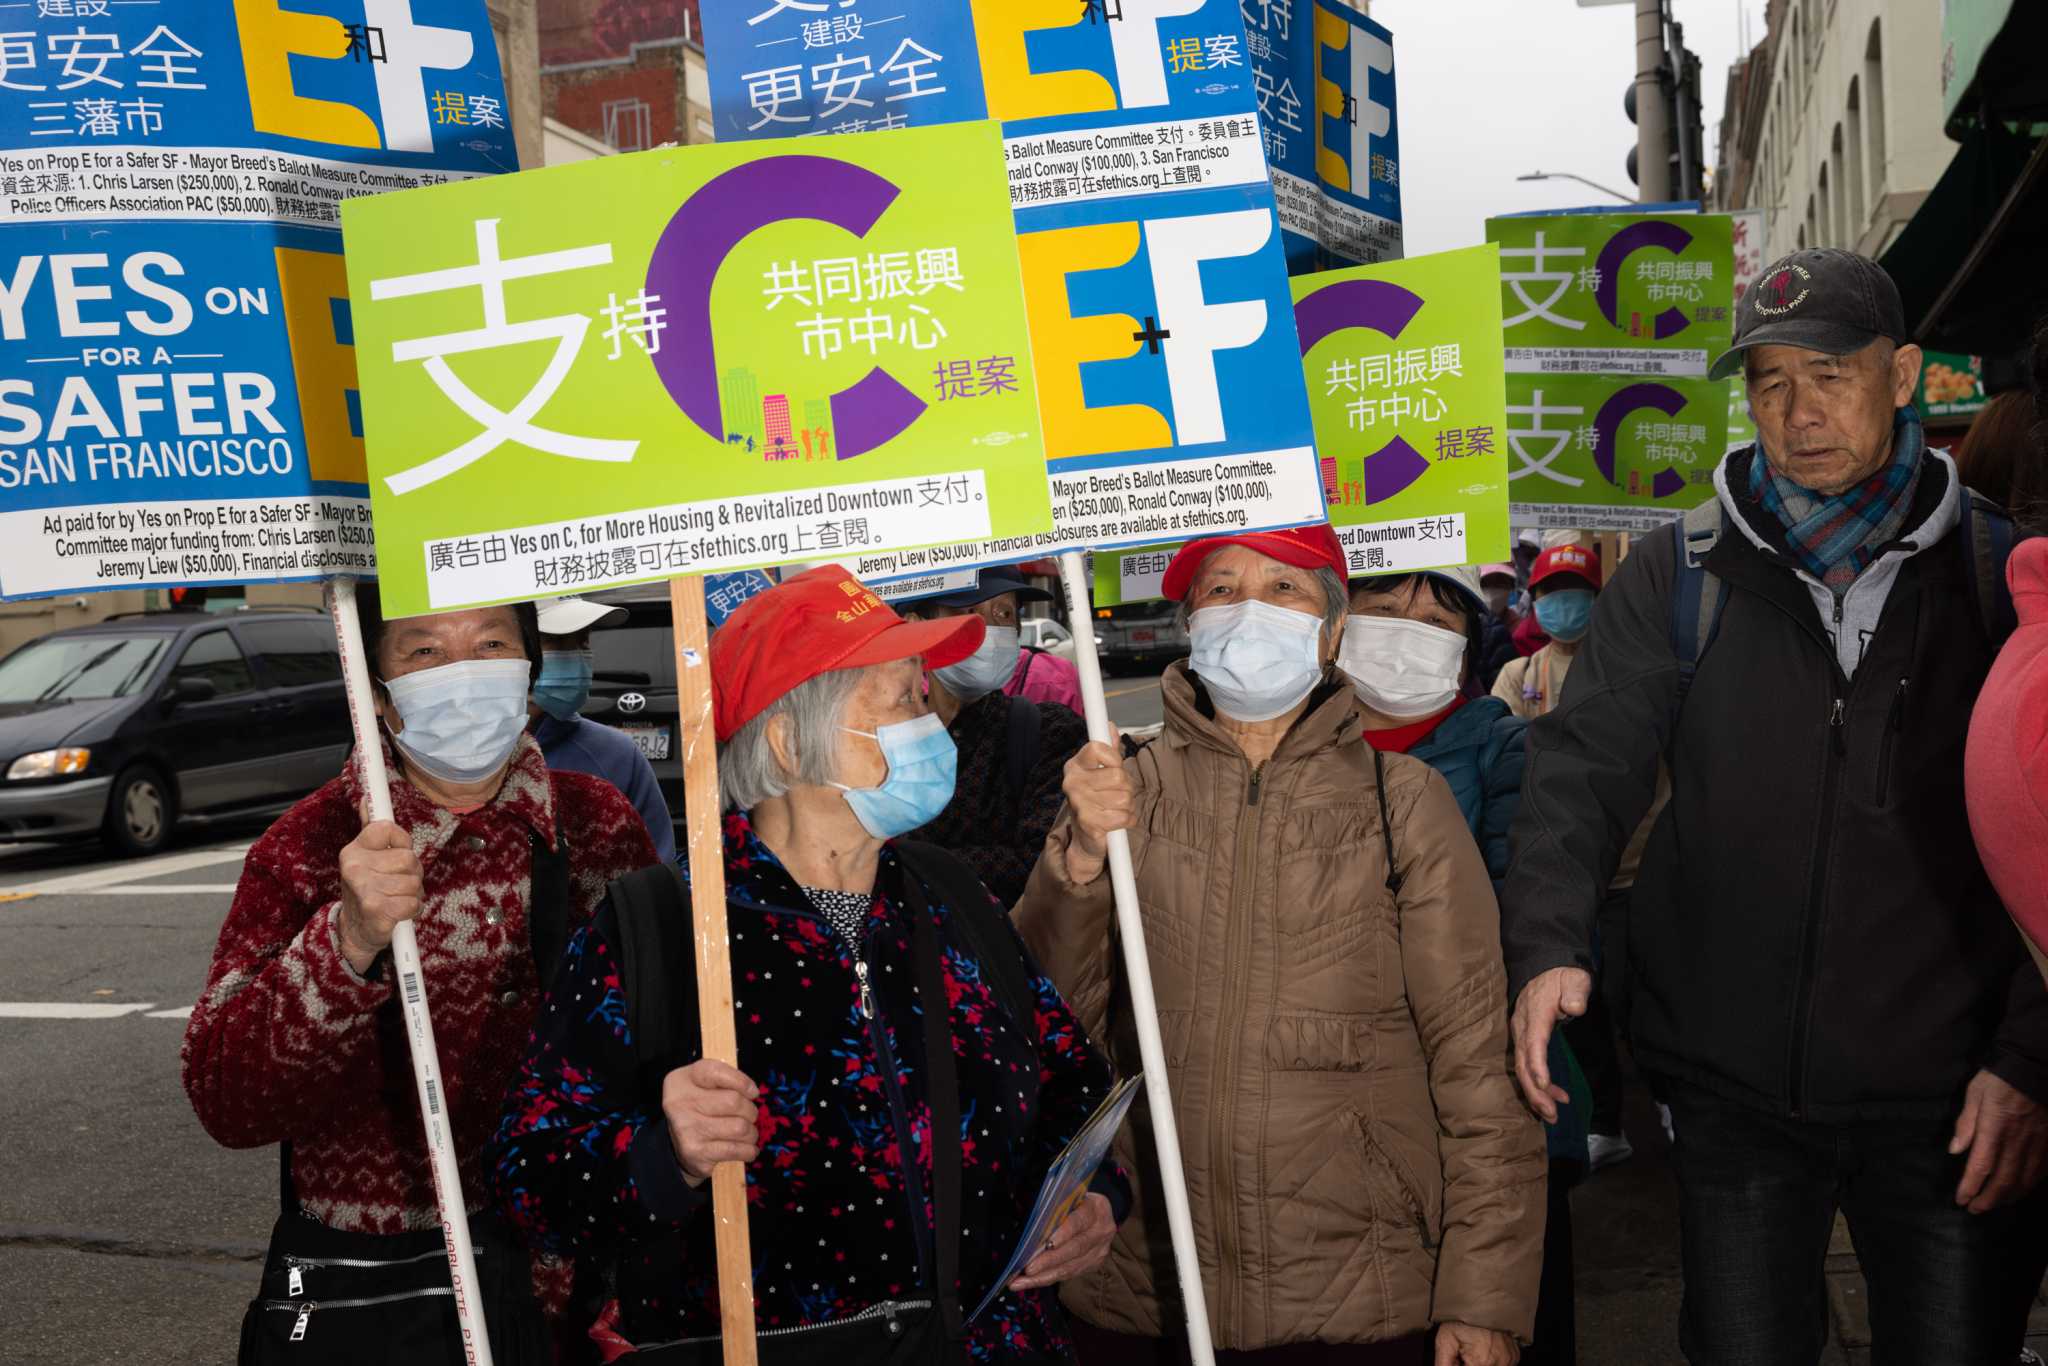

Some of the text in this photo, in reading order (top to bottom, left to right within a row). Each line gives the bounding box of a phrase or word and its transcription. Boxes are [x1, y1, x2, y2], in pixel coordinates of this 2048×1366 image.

[800, 13, 865, 50] 建設
[1166, 33, 1243, 74] 提案
[741, 38, 946, 132] 更安全
[28, 96, 164, 136] 三藩市
[432, 90, 506, 129] 提案
[1012, 142, 1045, 160] Ballot
[1046, 136, 1093, 155] Measure
[1095, 129, 1154, 150] Committee
[1034, 156, 1078, 177] Conway
[1081, 153, 1139, 177] ($100,000),
[1140, 151, 1151, 166] 3.
[1152, 149, 1175, 164] San
[1176, 145, 1230, 162] Francisco
[1, 157, 24, 172] Yes
[27, 158, 44, 171] on
[47, 153, 79, 172] Prop
[81, 152, 92, 168] E
[95, 152, 113, 168] for
[116, 156, 124, 168] a
[126, 151, 160, 169] Safer
[162, 153, 178, 169] SF
[190, 153, 228, 173] Mayor
[230, 154, 276, 172] Breed's
[278, 157, 311, 177] Ballot
[311, 163, 357, 184] Measure
[359, 169, 419, 189] Committee
[78, 174, 90, 190] 1.
[93, 173, 128, 190] Chris
[130, 174, 174, 191] Larsen
[177, 174, 243, 195] ($250,000),
[245, 175, 256, 191] 2.
[258, 176, 299, 195] Ronald
[301, 181, 344, 201] Conway
[54, 195, 106, 213] Officers
[109, 195, 184, 212] Association
[186, 195, 213, 212] PAC
[216, 195, 274, 217] ($50,000).
[762, 247, 966, 312] 共同振興
[1636, 261, 1714, 281] 共同振興
[0, 251, 270, 340] YES ON
[1647, 284, 1704, 302] 市中心
[795, 304, 948, 361] 市中心
[82, 346, 173, 367] FOR A
[1325, 343, 1464, 396] 共同振興
[933, 354, 1019, 404] 提案
[0, 371, 287, 445] SAFER
[1345, 387, 1448, 432] 市中心
[1435, 425, 1496, 461] 提案
[1635, 422, 1707, 444] 共同振興
[0, 438, 294, 488] SAN FRANCISCO
[1646, 444, 1697, 463] 市中心
[1053, 459, 1276, 500] Mayor Breed's Ballot Measure Committee.
[43, 514, 63, 535] Ad
[65, 512, 95, 536] paid
[97, 511, 116, 530] for
[118, 510, 135, 533] by
[137, 508, 162, 528] Yes
[165, 512, 182, 527] on
[184, 507, 215, 529] Prop
[216, 506, 228, 525] E
[229, 505, 247, 524] for
[250, 511, 258, 524] a
[260, 504, 292, 524] Safer
[294, 503, 311, 522] SF
[321, 502, 356, 525] Mayor
[1068, 495, 1127, 520] ($250,000),
[1129, 491, 1167, 512] Ronald
[1168, 488, 1212, 507] Conway
[1214, 480, 1273, 505] ($100,000),
[55, 535, 128, 557] Committee
[131, 533, 167, 555] major
[170, 531, 220, 553] funding
[222, 530, 256, 549] from:
[257, 528, 291, 546] Chris
[293, 526, 336, 545] Larsen
[430, 534, 507, 572] 廣告由
[510, 534, 537, 556] Yes
[540, 534, 559, 551] on
[562, 526, 577, 549] C,
[580, 523, 602, 545] for
[605, 520, 645, 541] More
[648, 507, 714, 535] Housing
[718, 506, 730, 525] &
[734, 492, 823, 523] Revitalized
[827, 486, 913, 512] Downtown
[856, 553, 897, 576] Jeremy
[900, 549, 927, 566] Liew
[1100, 523, 1118, 537] are
[1120, 514, 1168, 534] available
[1169, 513, 1181, 529] at
[1182, 508, 1249, 530] sfethics.org.
[1356, 525, 1416, 547] Downtown
[96, 558, 144, 580] Jeremy
[147, 556, 178, 575] Liew
[181, 553, 241, 578] ($50,000).
[243, 550, 298, 571] Financial
[301, 549, 367, 569] disclosures
[442, 1218, 468, 1318] CHARLOTTE
